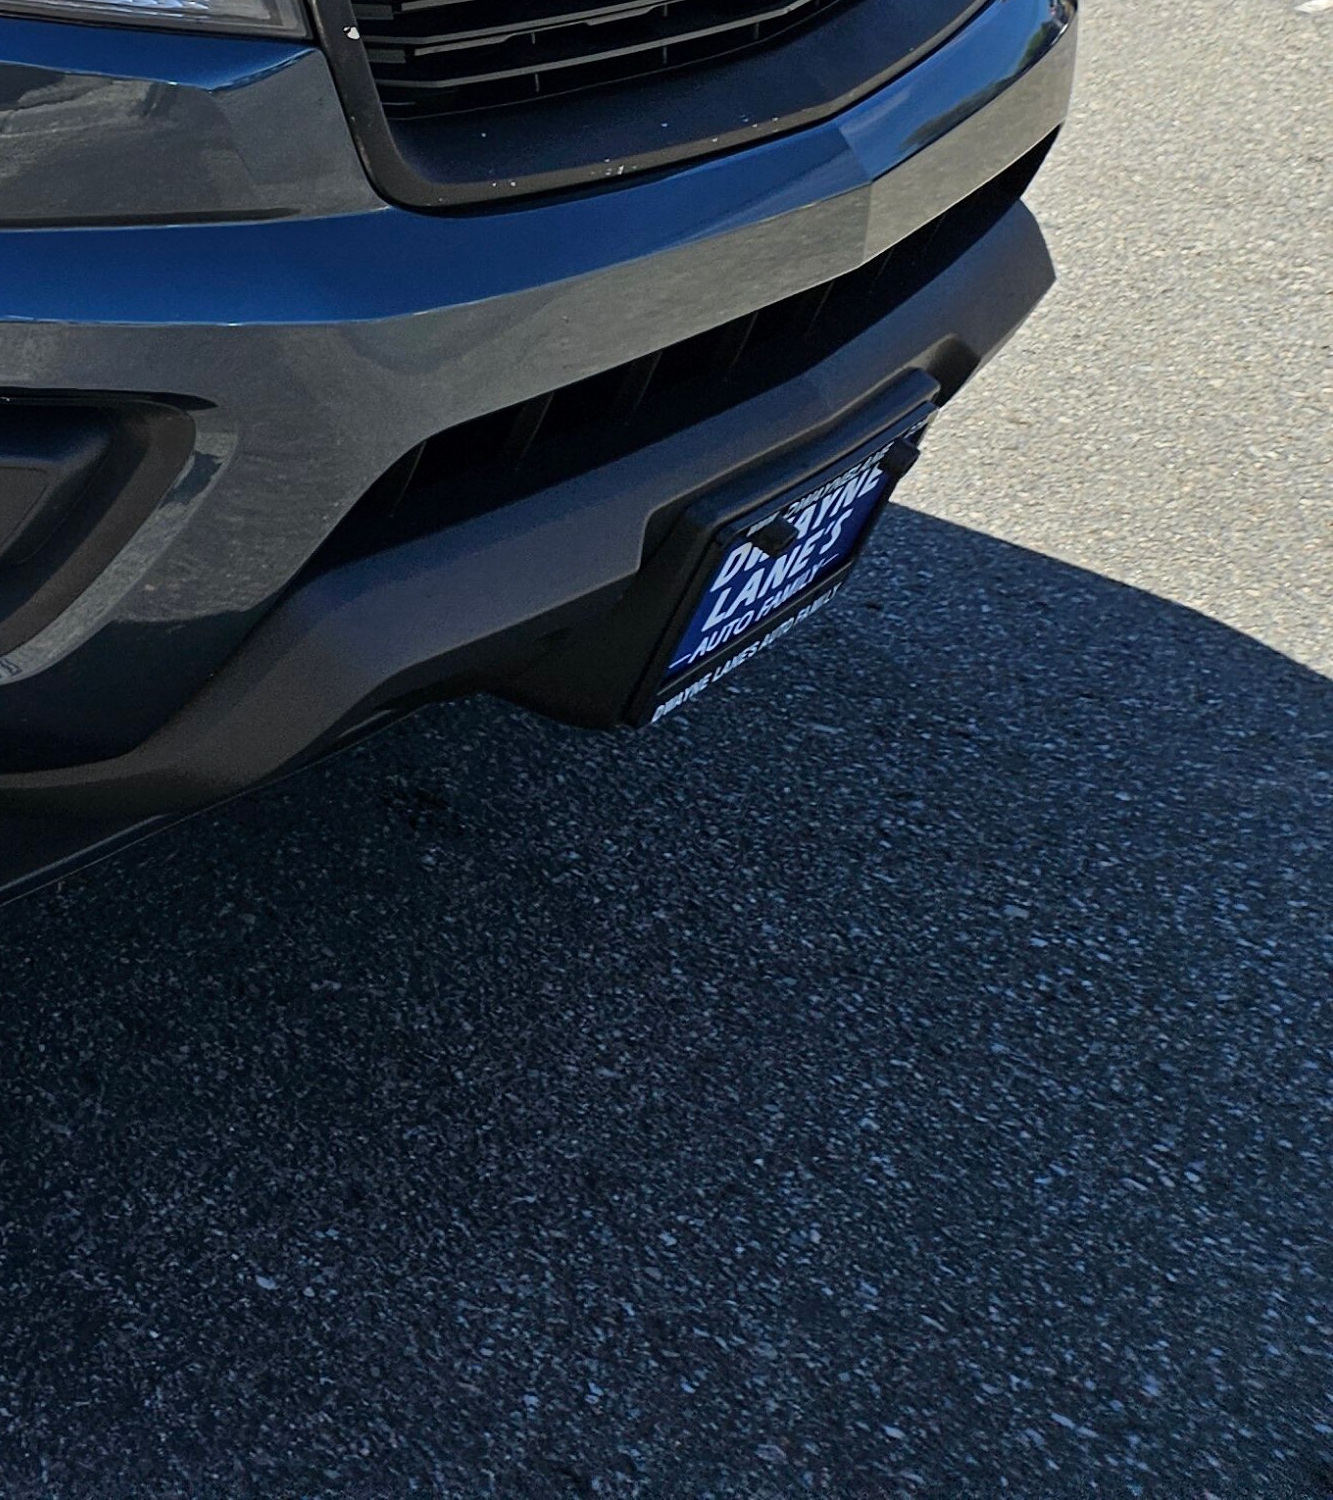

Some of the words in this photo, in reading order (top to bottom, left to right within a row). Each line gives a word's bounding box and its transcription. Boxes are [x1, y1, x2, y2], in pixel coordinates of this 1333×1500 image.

[688, 614, 752, 663] AUTO
[755, 558, 825, 622] FAMILY
[701, 507, 855, 632] LANE'S
